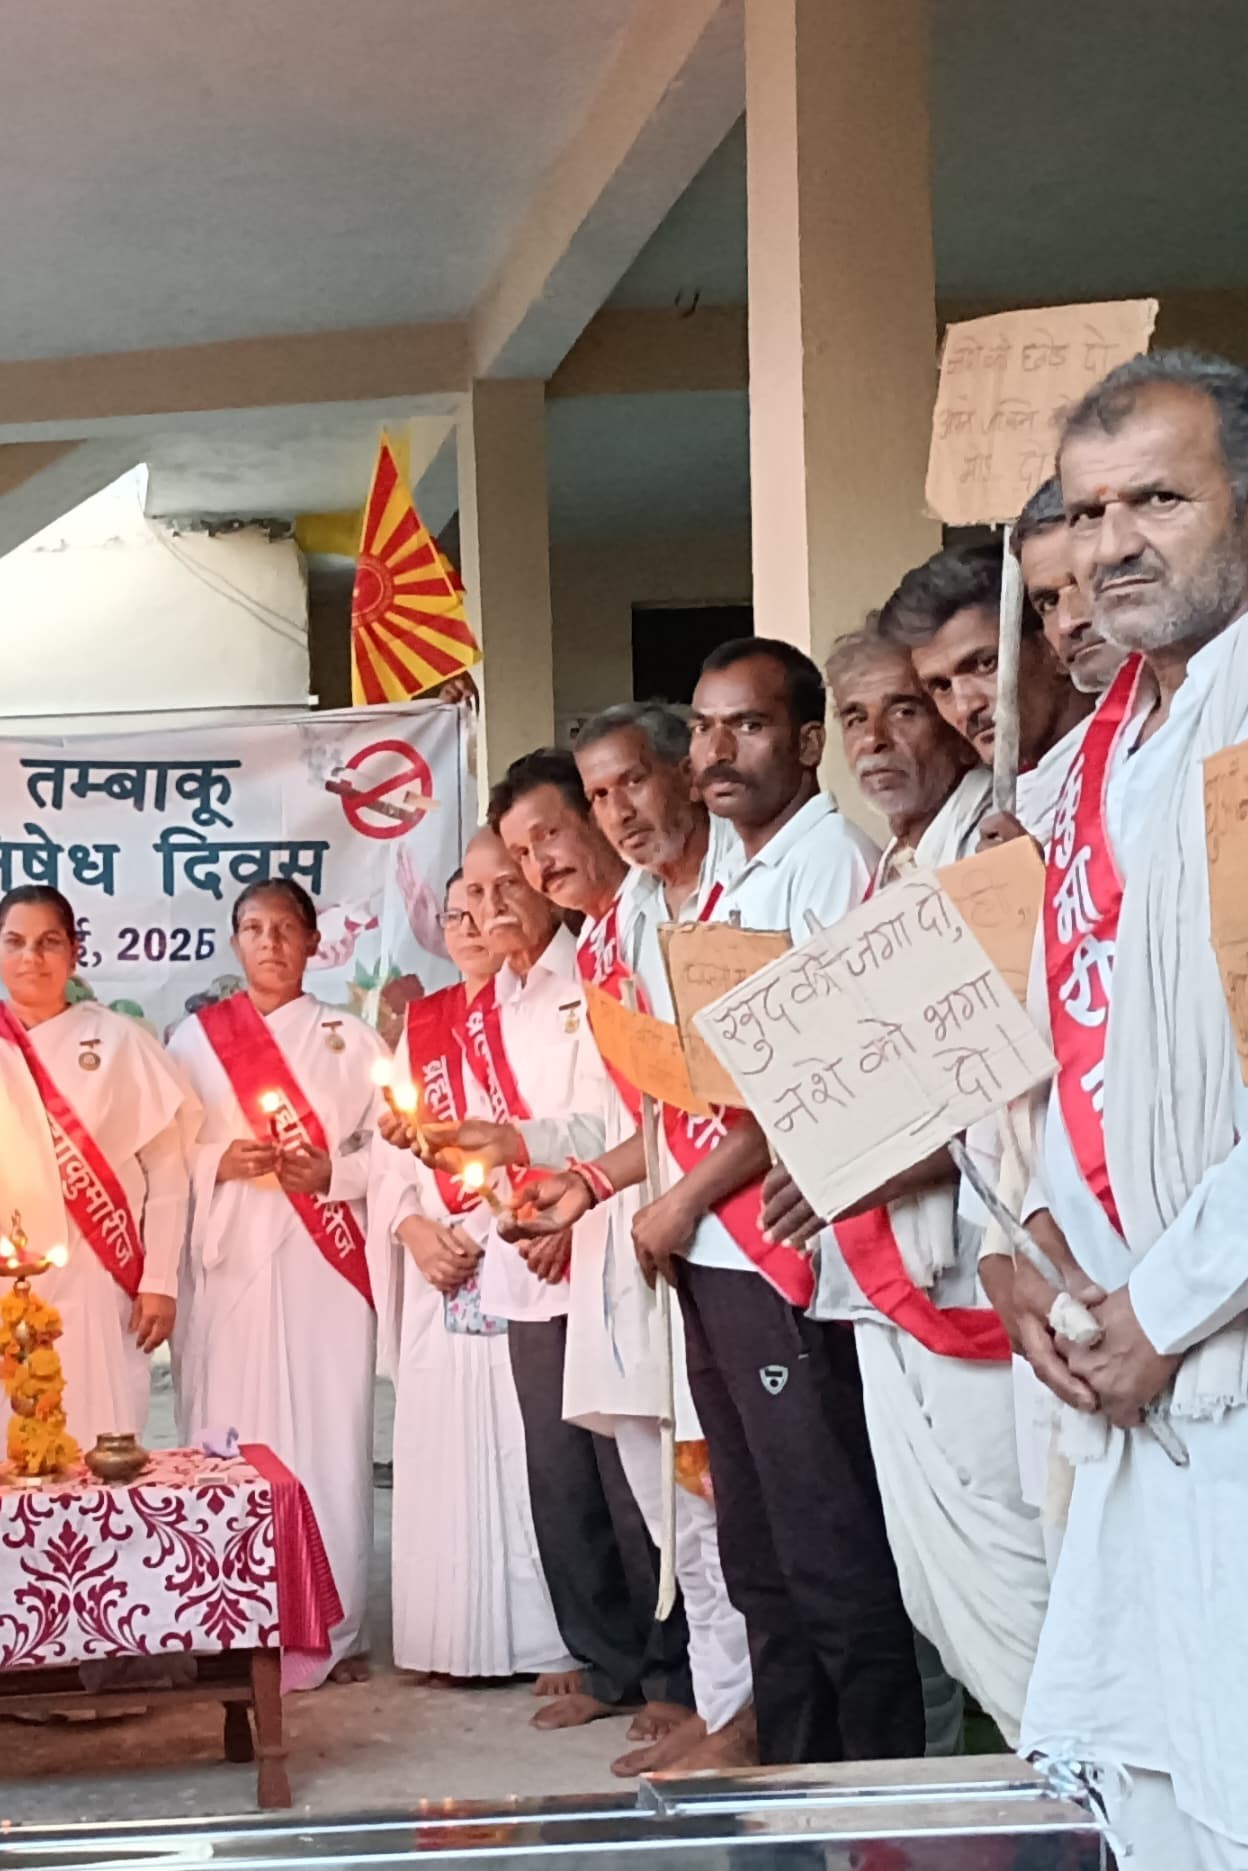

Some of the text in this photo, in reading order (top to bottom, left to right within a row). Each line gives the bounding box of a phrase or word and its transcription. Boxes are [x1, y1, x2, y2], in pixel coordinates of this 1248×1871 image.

[20, 758, 241, 827] तम्बाकू
[152, 825, 330, 900] दिवस
[117, 927, 216, 961] 2025
[845, 911, 914, 977] जगा
[773, 1057, 857, 1133] नशे
[858, 1018, 917, 1074] को
[923, 969, 1000, 1042] भगा
